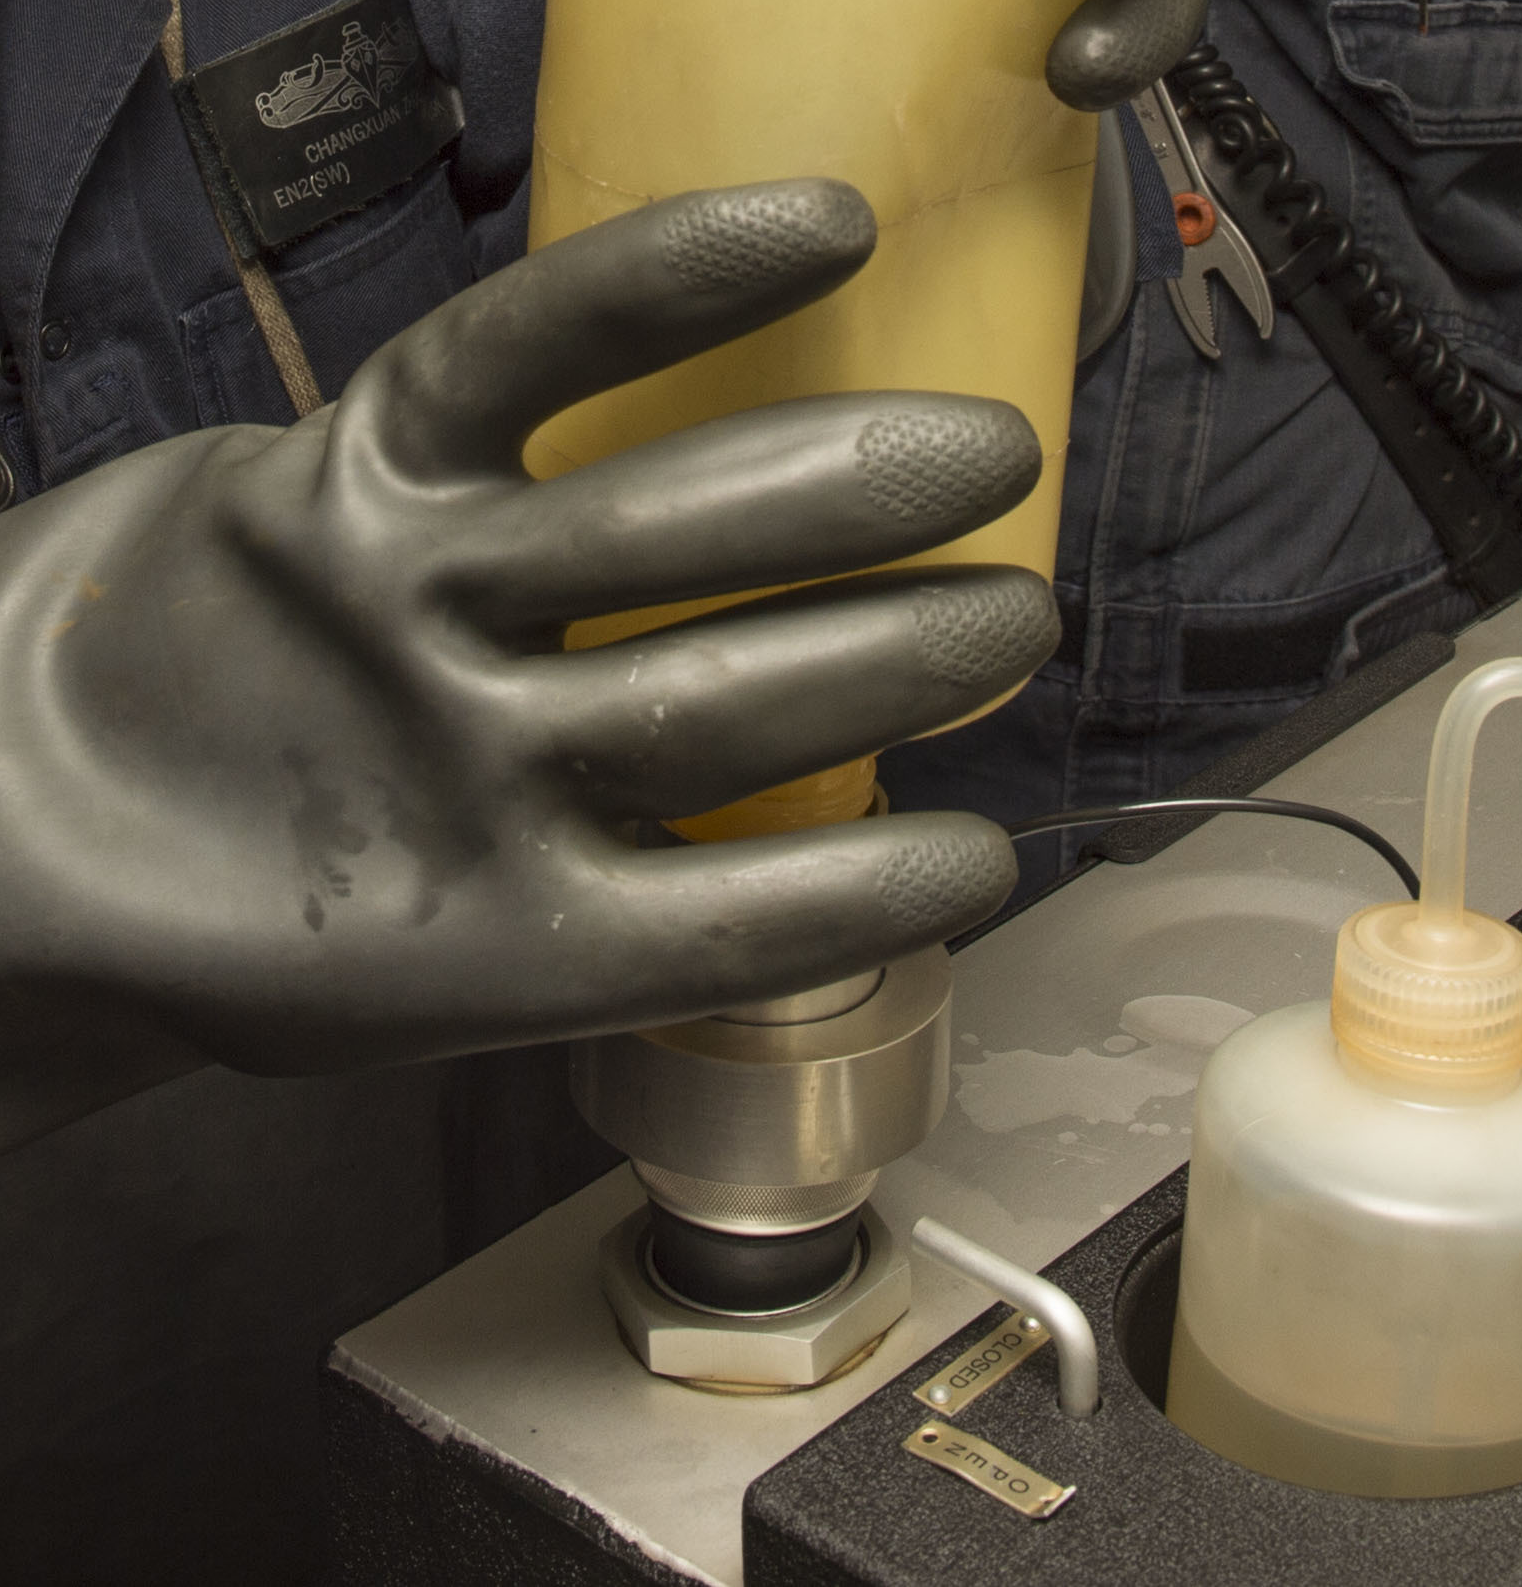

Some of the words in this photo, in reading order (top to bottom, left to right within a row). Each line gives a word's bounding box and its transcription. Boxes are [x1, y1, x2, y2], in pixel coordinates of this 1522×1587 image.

[304, 104, 401, 164] CHANGXUAN
[273, 160, 351, 210] EN2(SW)
[948, 1331, 1022, 1390] CLOSED
[943, 1441, 1030, 1495] OPEN
